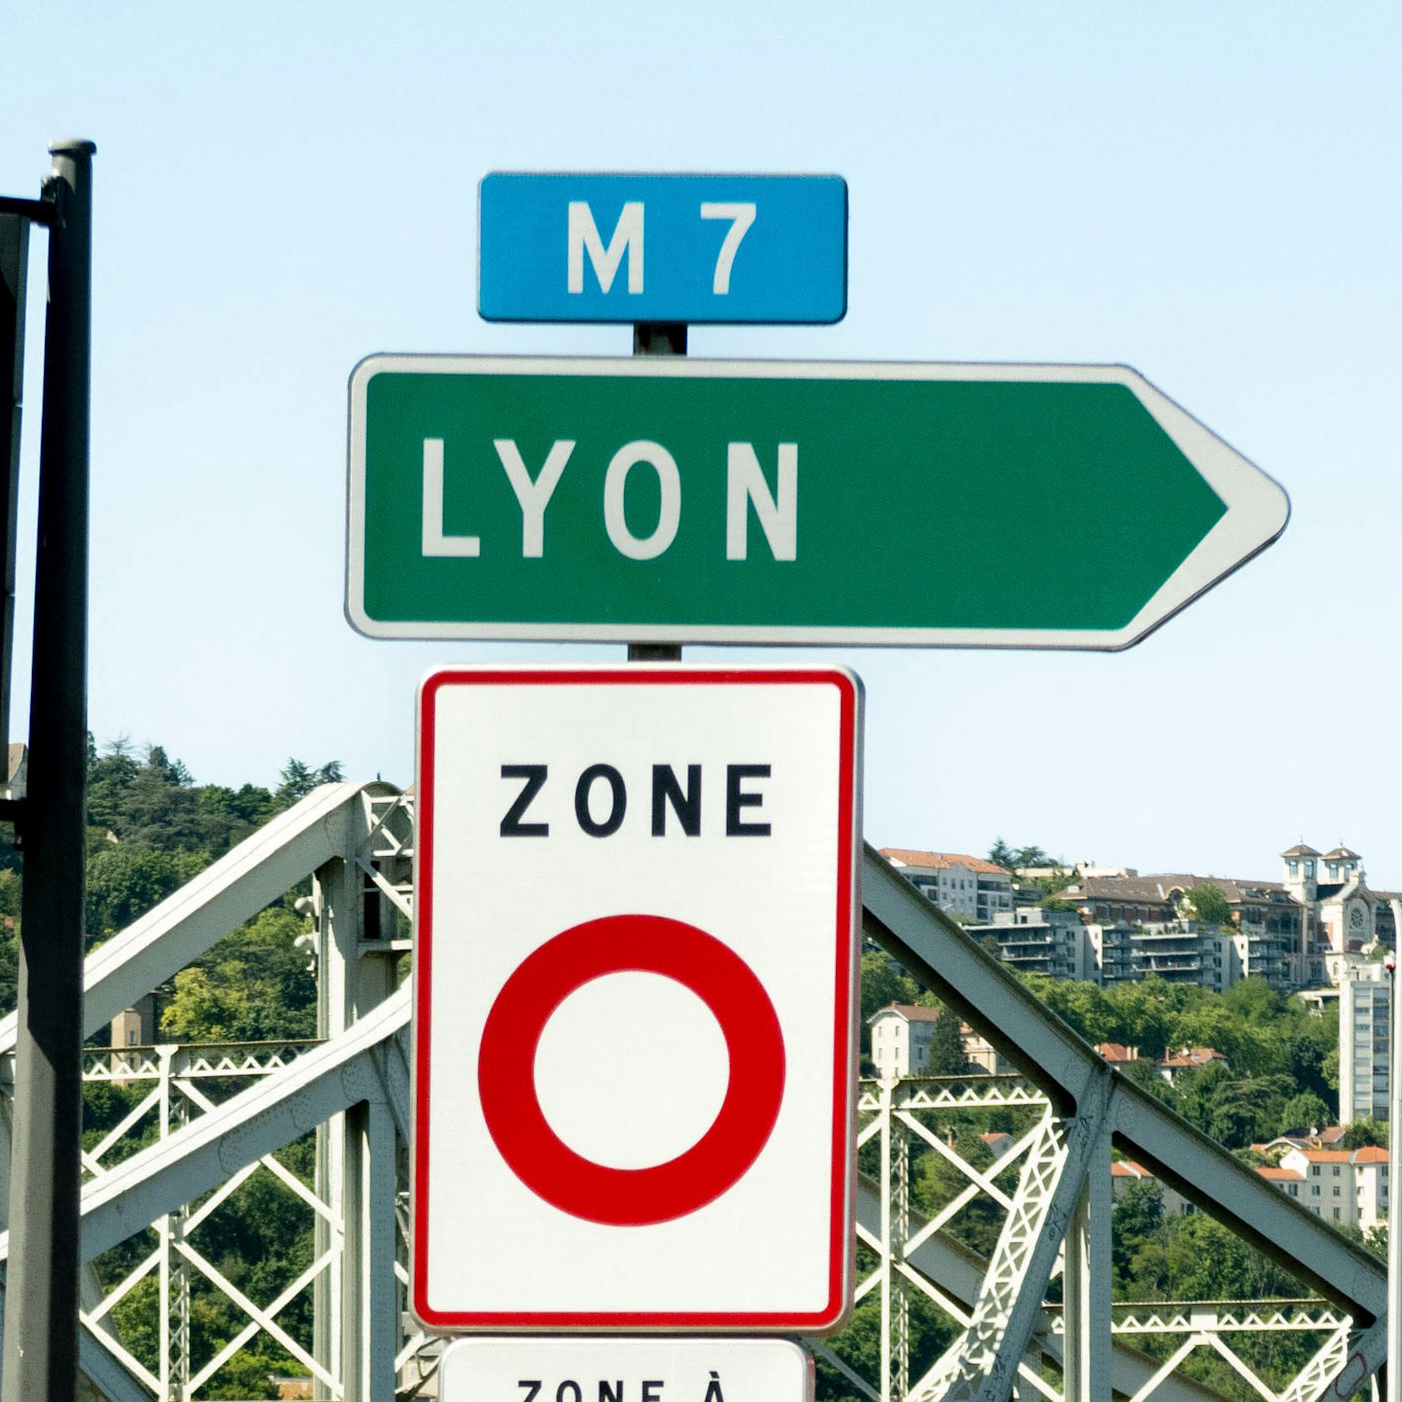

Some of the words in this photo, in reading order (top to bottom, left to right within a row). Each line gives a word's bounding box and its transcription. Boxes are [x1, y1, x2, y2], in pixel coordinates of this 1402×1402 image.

[568, 201, 644, 294] M
[701, 202, 756, 294] 7
[422, 438, 798, 561] LYON
[500, 764, 771, 838] ZONE
